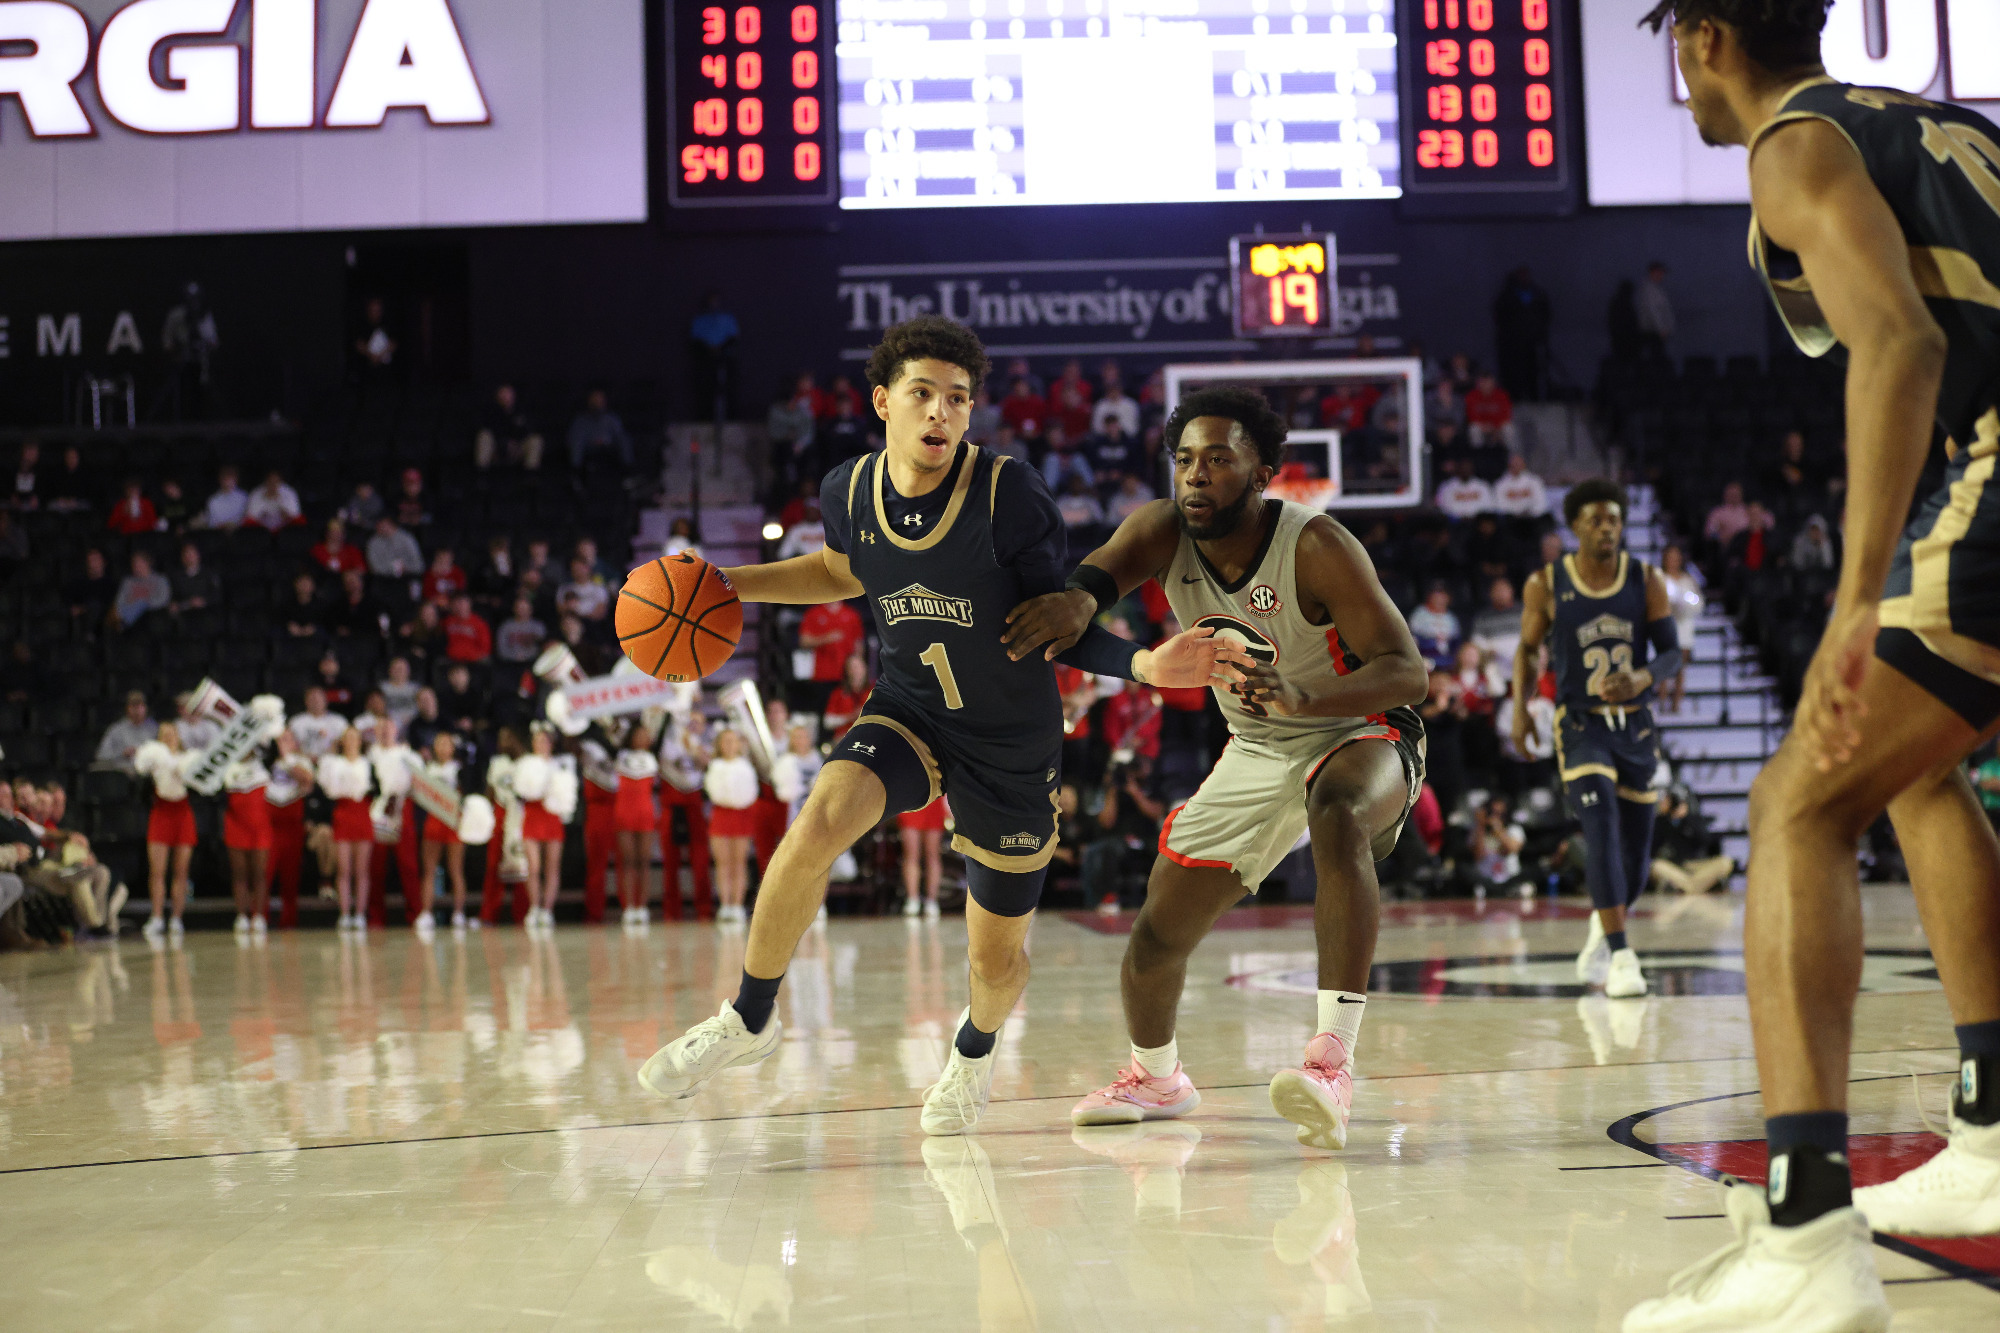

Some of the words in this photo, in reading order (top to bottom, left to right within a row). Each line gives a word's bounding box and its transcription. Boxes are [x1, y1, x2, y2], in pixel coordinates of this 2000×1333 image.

[702, 6, 726, 45] 3
[735, 5, 761, 44] 0
[791, 5, 817, 43] 0
[1424, 0, 1460, 30] 11
[1468, 0, 1493, 31] 0
[1522, 0, 1547, 31] 0
[701, 53, 727, 88] 4
[736, 51, 762, 89] 0
[792, 50, 818, 88] 0
[1425, 39, 1460, 76] 12
[1468, 38, 1495, 76] 0
[1523, 38, 1550, 76] 0
[693, 98, 728, 136] 10
[737, 97, 763, 135] 0
[793, 96, 819, 135] 0
[1427, 84, 1462, 122] 13
[1470, 83, 1497, 122] 0
[1525, 83, 1552, 121] 0
[681, 145, 729, 183] 54
[738, 143, 764, 182] 0
[794, 142, 820, 181] 0
[1417, 129, 1464, 168] 23
[1472, 129, 1498, 167] 0
[1527, 128, 1553, 167] 0
[838, 281, 932, 330] The
[935, 278, 1162, 338] University
[1163, 274, 1219, 323] of
[1269, 275, 1319, 325] 19
[882, 598, 909, 619] THE
[910, 598, 968, 621] MOUNT
[1250, 608, 1279, 618] GRADUATE
[1252, 586, 1275, 610] SEC
[919, 642, 964, 710] 1
[1002, 838, 1017, 846] THE
[1018, 838, 1040, 848] MOUNT
